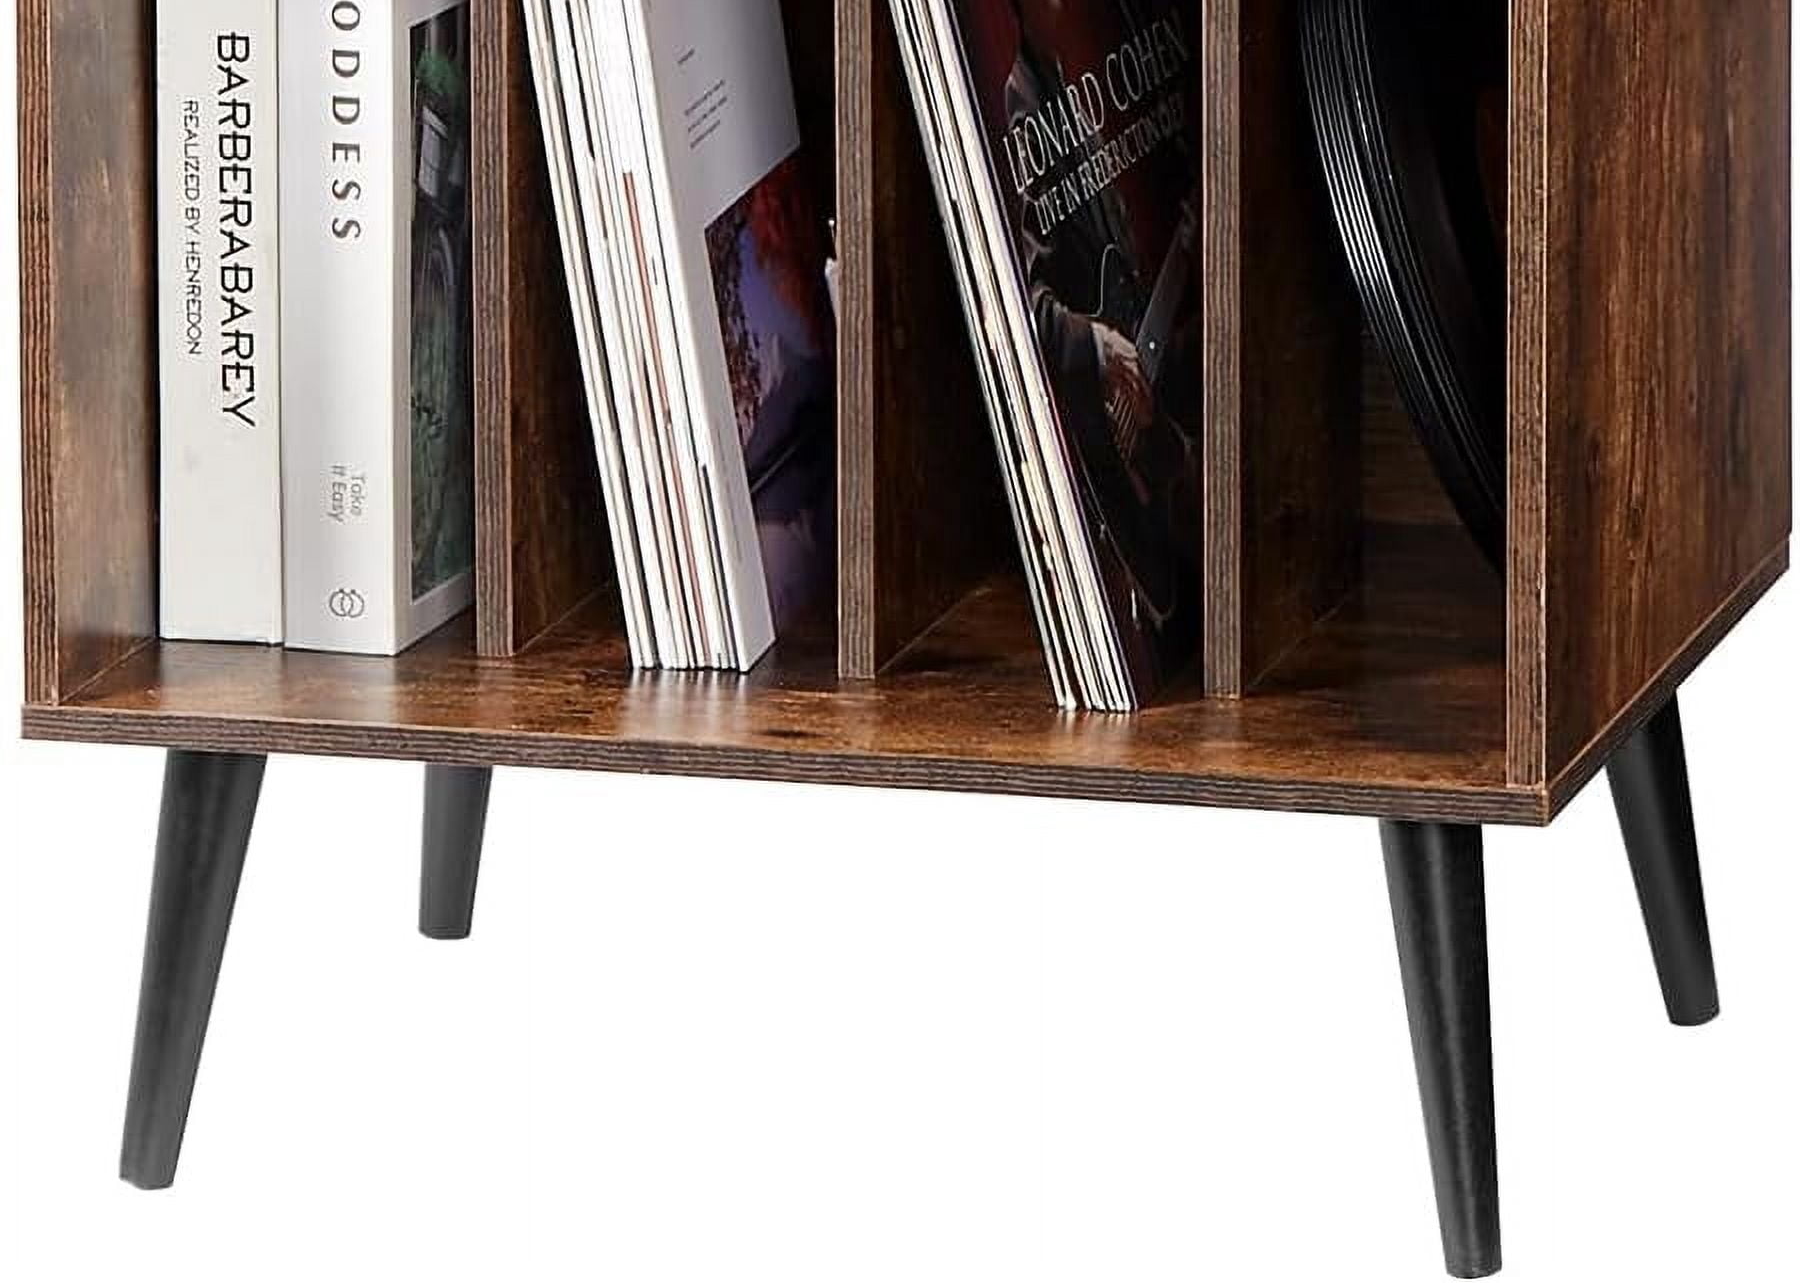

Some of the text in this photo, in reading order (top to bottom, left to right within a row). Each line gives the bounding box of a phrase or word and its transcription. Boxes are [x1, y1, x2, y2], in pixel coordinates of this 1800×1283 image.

[183, 99, 203, 355] REALIZED BY HENREDON
[217, 31, 255, 428] BARBERABAREY
[1002, 71, 1105, 196] LEONARD
